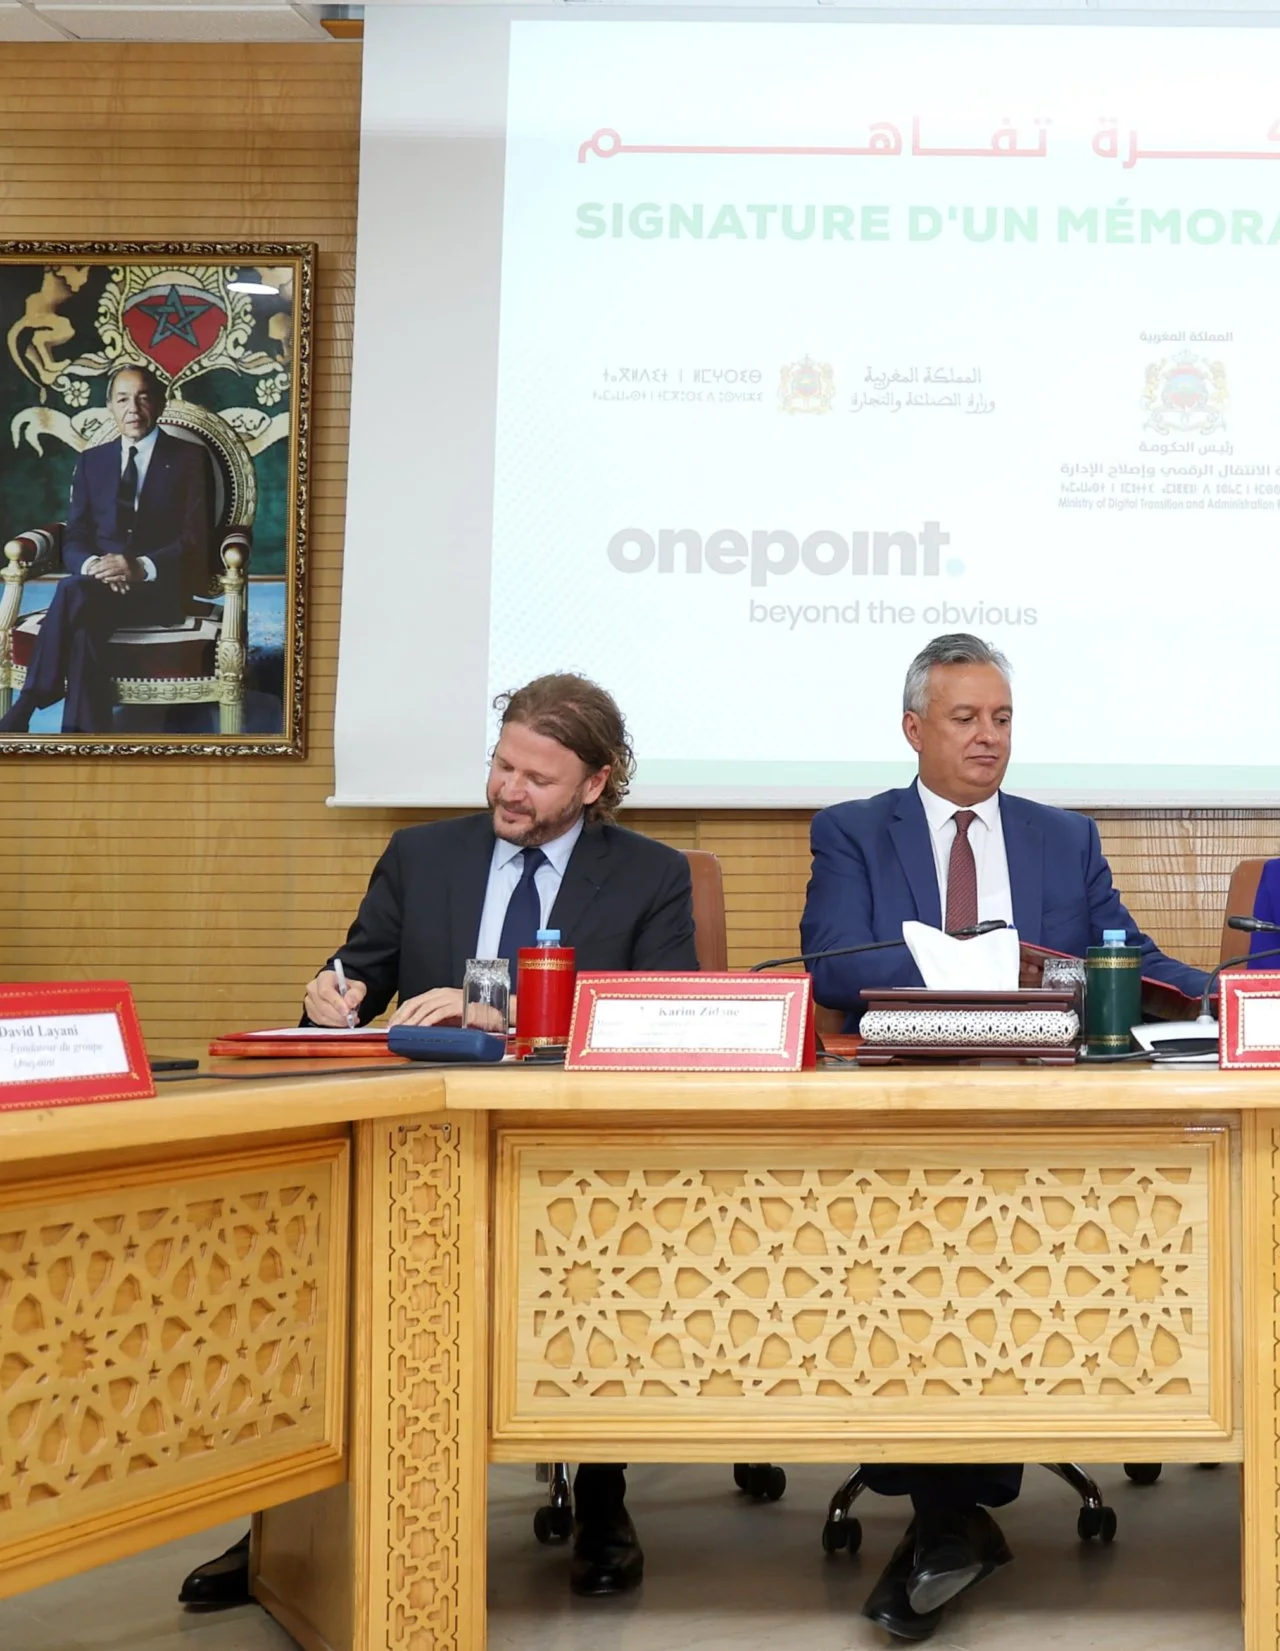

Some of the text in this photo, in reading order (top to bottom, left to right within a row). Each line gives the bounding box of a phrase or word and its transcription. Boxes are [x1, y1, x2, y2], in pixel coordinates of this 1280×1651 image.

[575, 202, 890, 241] SIGNATURE
[908, 205, 1040, 243] D'UN
[863, 365, 982, 390] المملكة المغربية
[848, 391, 997, 415] وزارة الصناعة والتجارة
[1138, 440, 1234, 455] رئيس الحكومة
[1160, 464, 1214, 479] الرقمي
[1217, 464, 1270, 479] الانتقال
[1058, 498, 1093, 510] Ministry
[1096, 498, 1106, 509] of
[1108, 498, 1138, 511] Digital
[1140, 498, 1184, 510] Transition
[1186, 499, 1205, 510] and
[1207, 498, 1275, 511] Administration
[749, 600, 1039, 631] beyond the obvious
[0, 1024, 79, 1039] David Layani
